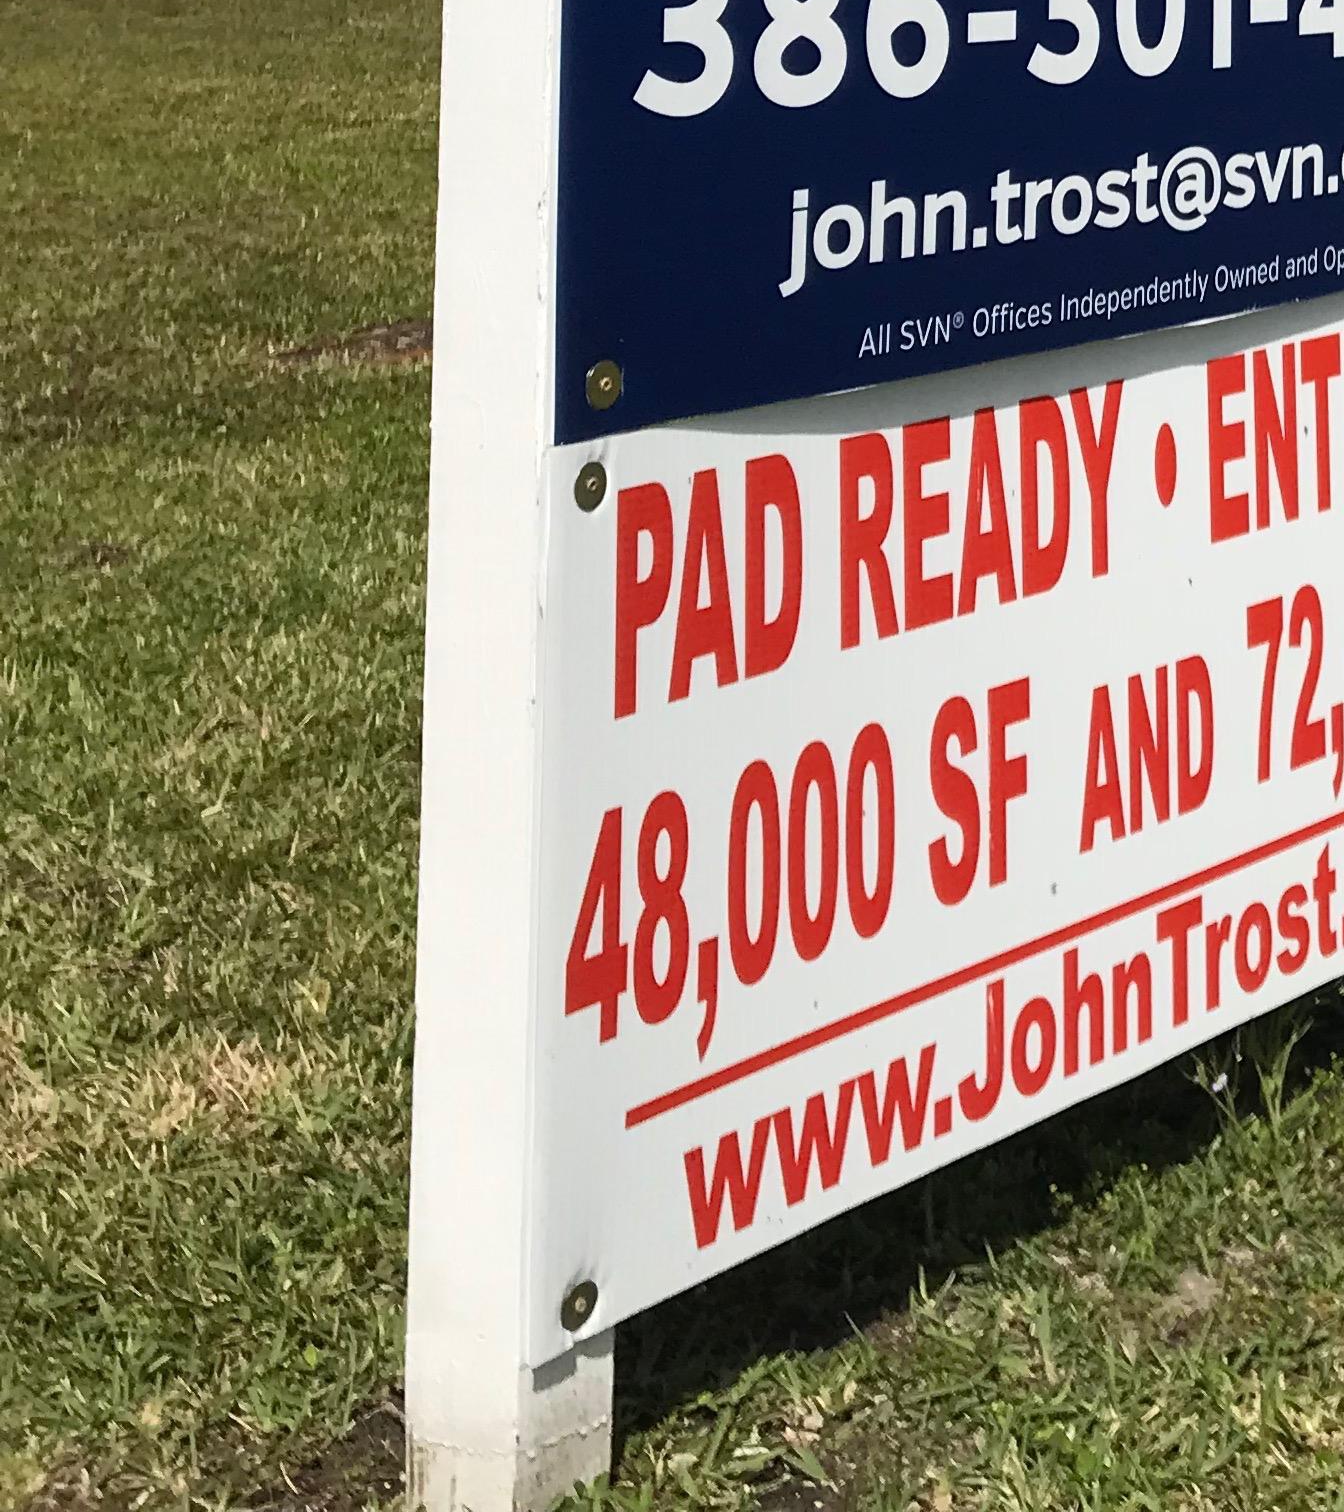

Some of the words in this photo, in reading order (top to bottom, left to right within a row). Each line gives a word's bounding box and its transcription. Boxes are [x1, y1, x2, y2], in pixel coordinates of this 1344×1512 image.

[858, 323, 892, 358] All
[973, 301, 1053, 338] Offices
[1059, 270, 1210, 322] Independently
[1214, 255, 1280, 292] Owned
[1285, 248, 1319, 279] and
[614, 454, 803, 719] PAD
[839, 379, 1125, 651] READY
[565, 722, 896, 1062] 48,000
[928, 677, 1031, 906] SF
[1079, 655, 1214, 854] AND
